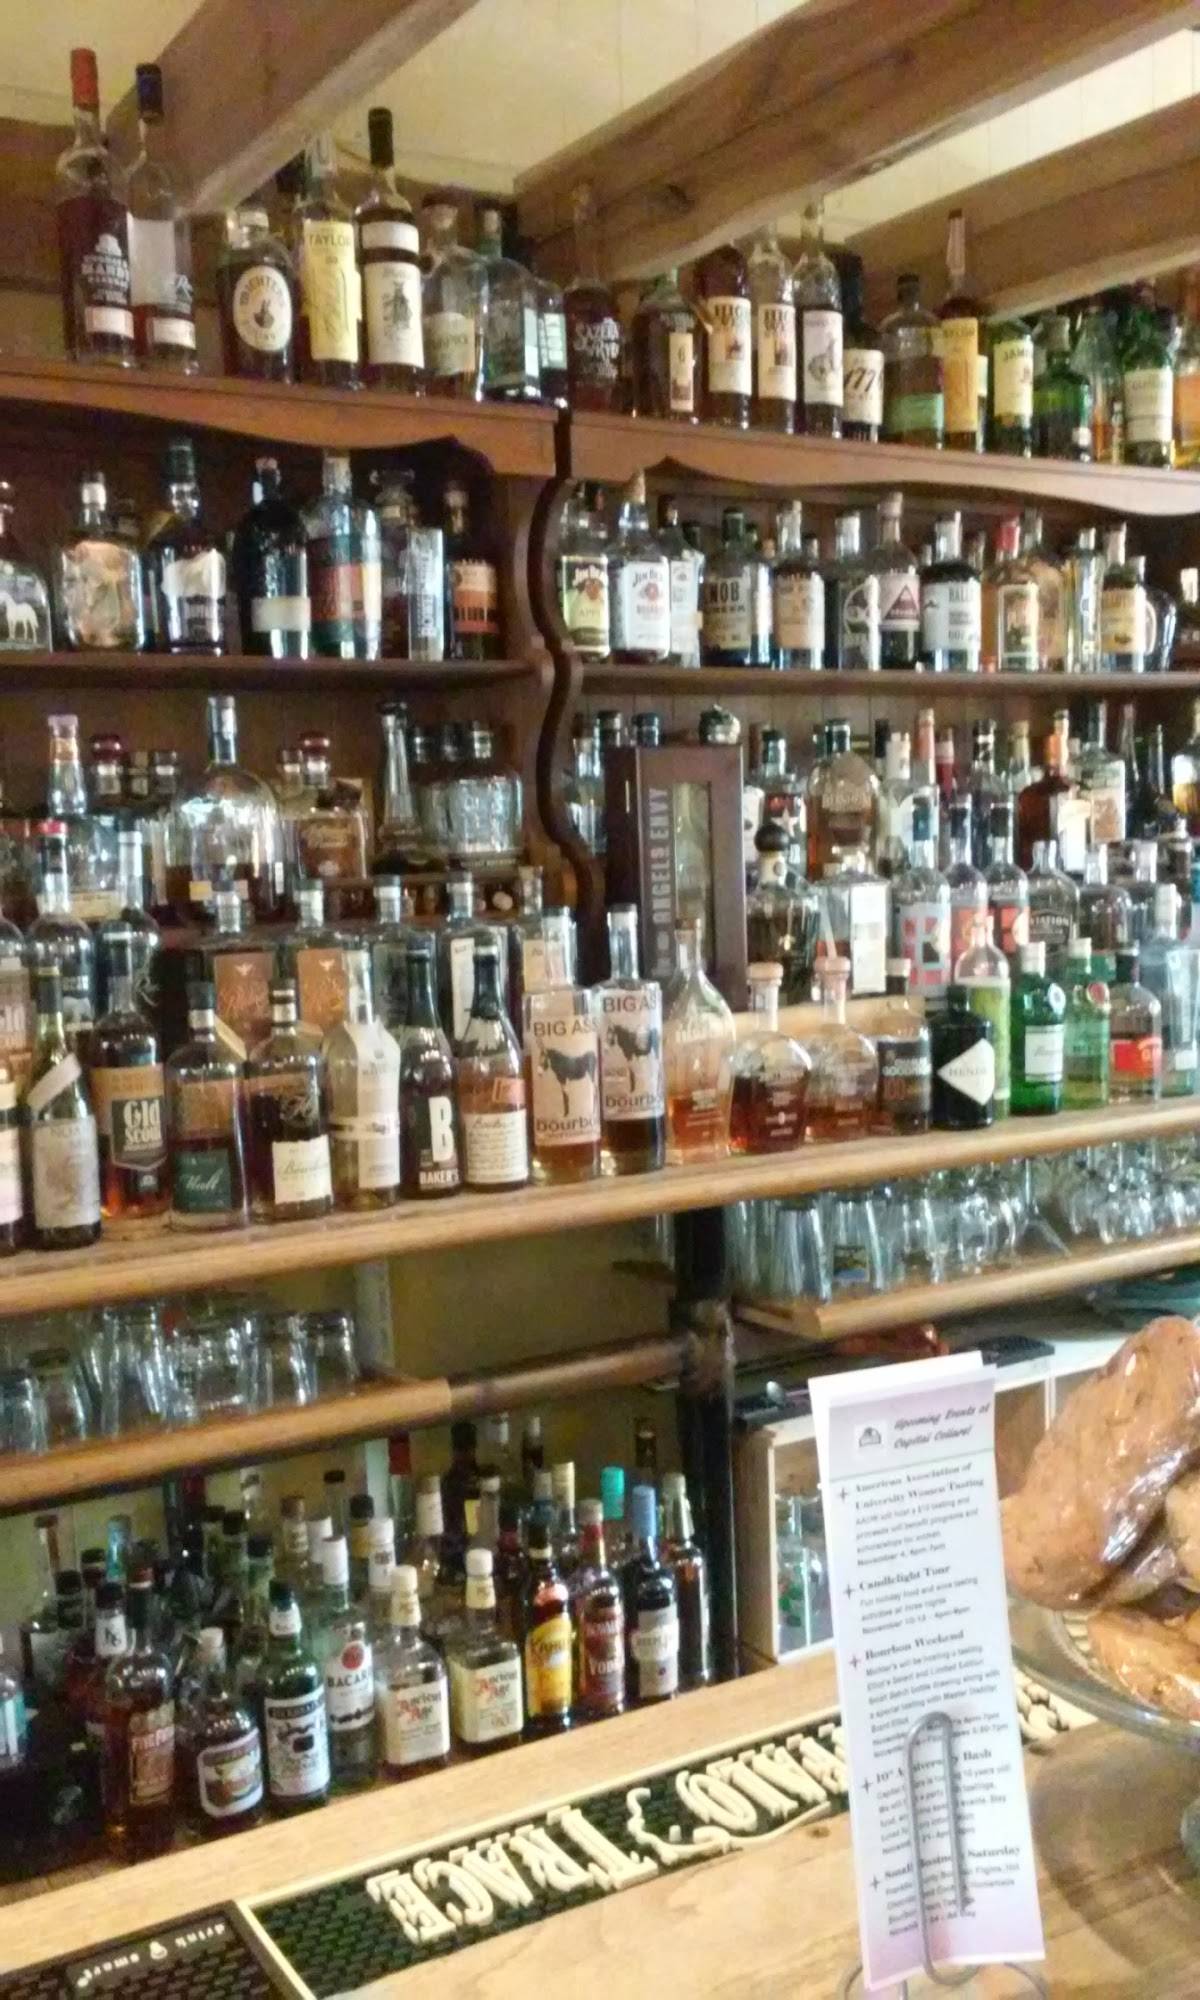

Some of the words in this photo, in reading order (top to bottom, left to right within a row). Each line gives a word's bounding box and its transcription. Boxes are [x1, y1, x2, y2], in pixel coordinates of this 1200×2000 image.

[601, 995, 638, 1013] BIG
[532, 1020, 568, 1037] BIG
[535, 1116, 598, 1133] bourbo
[418, 1169, 460, 1186] BAKER'S
[944, 1407, 975, 1418] Events
[894, 1435, 930, 1450] Capital
[856, 1477, 902, 1492] American
[905, 1464, 959, 1482] Association
[855, 1494, 905, 1509] University
[947, 1477, 984, 1492] Tasting
[857, 1554, 897, 1566] November
[858, 1570, 921, 1590] Candlelight
[922, 1563, 950, 1576] Tour
[862, 1620, 902, 1634] November
[865, 1642, 912, 1661] Bourbon
[914, 1630, 965, 1649] Weekend
[963, 1747, 992, 1762] Bash
[967, 1845, 1020, 1859] Saturday
[366, 1806, 659, 1944] TRACE
[174, 1922, 226, 1949] drink
[79, 1952, 141, 1985] smart
